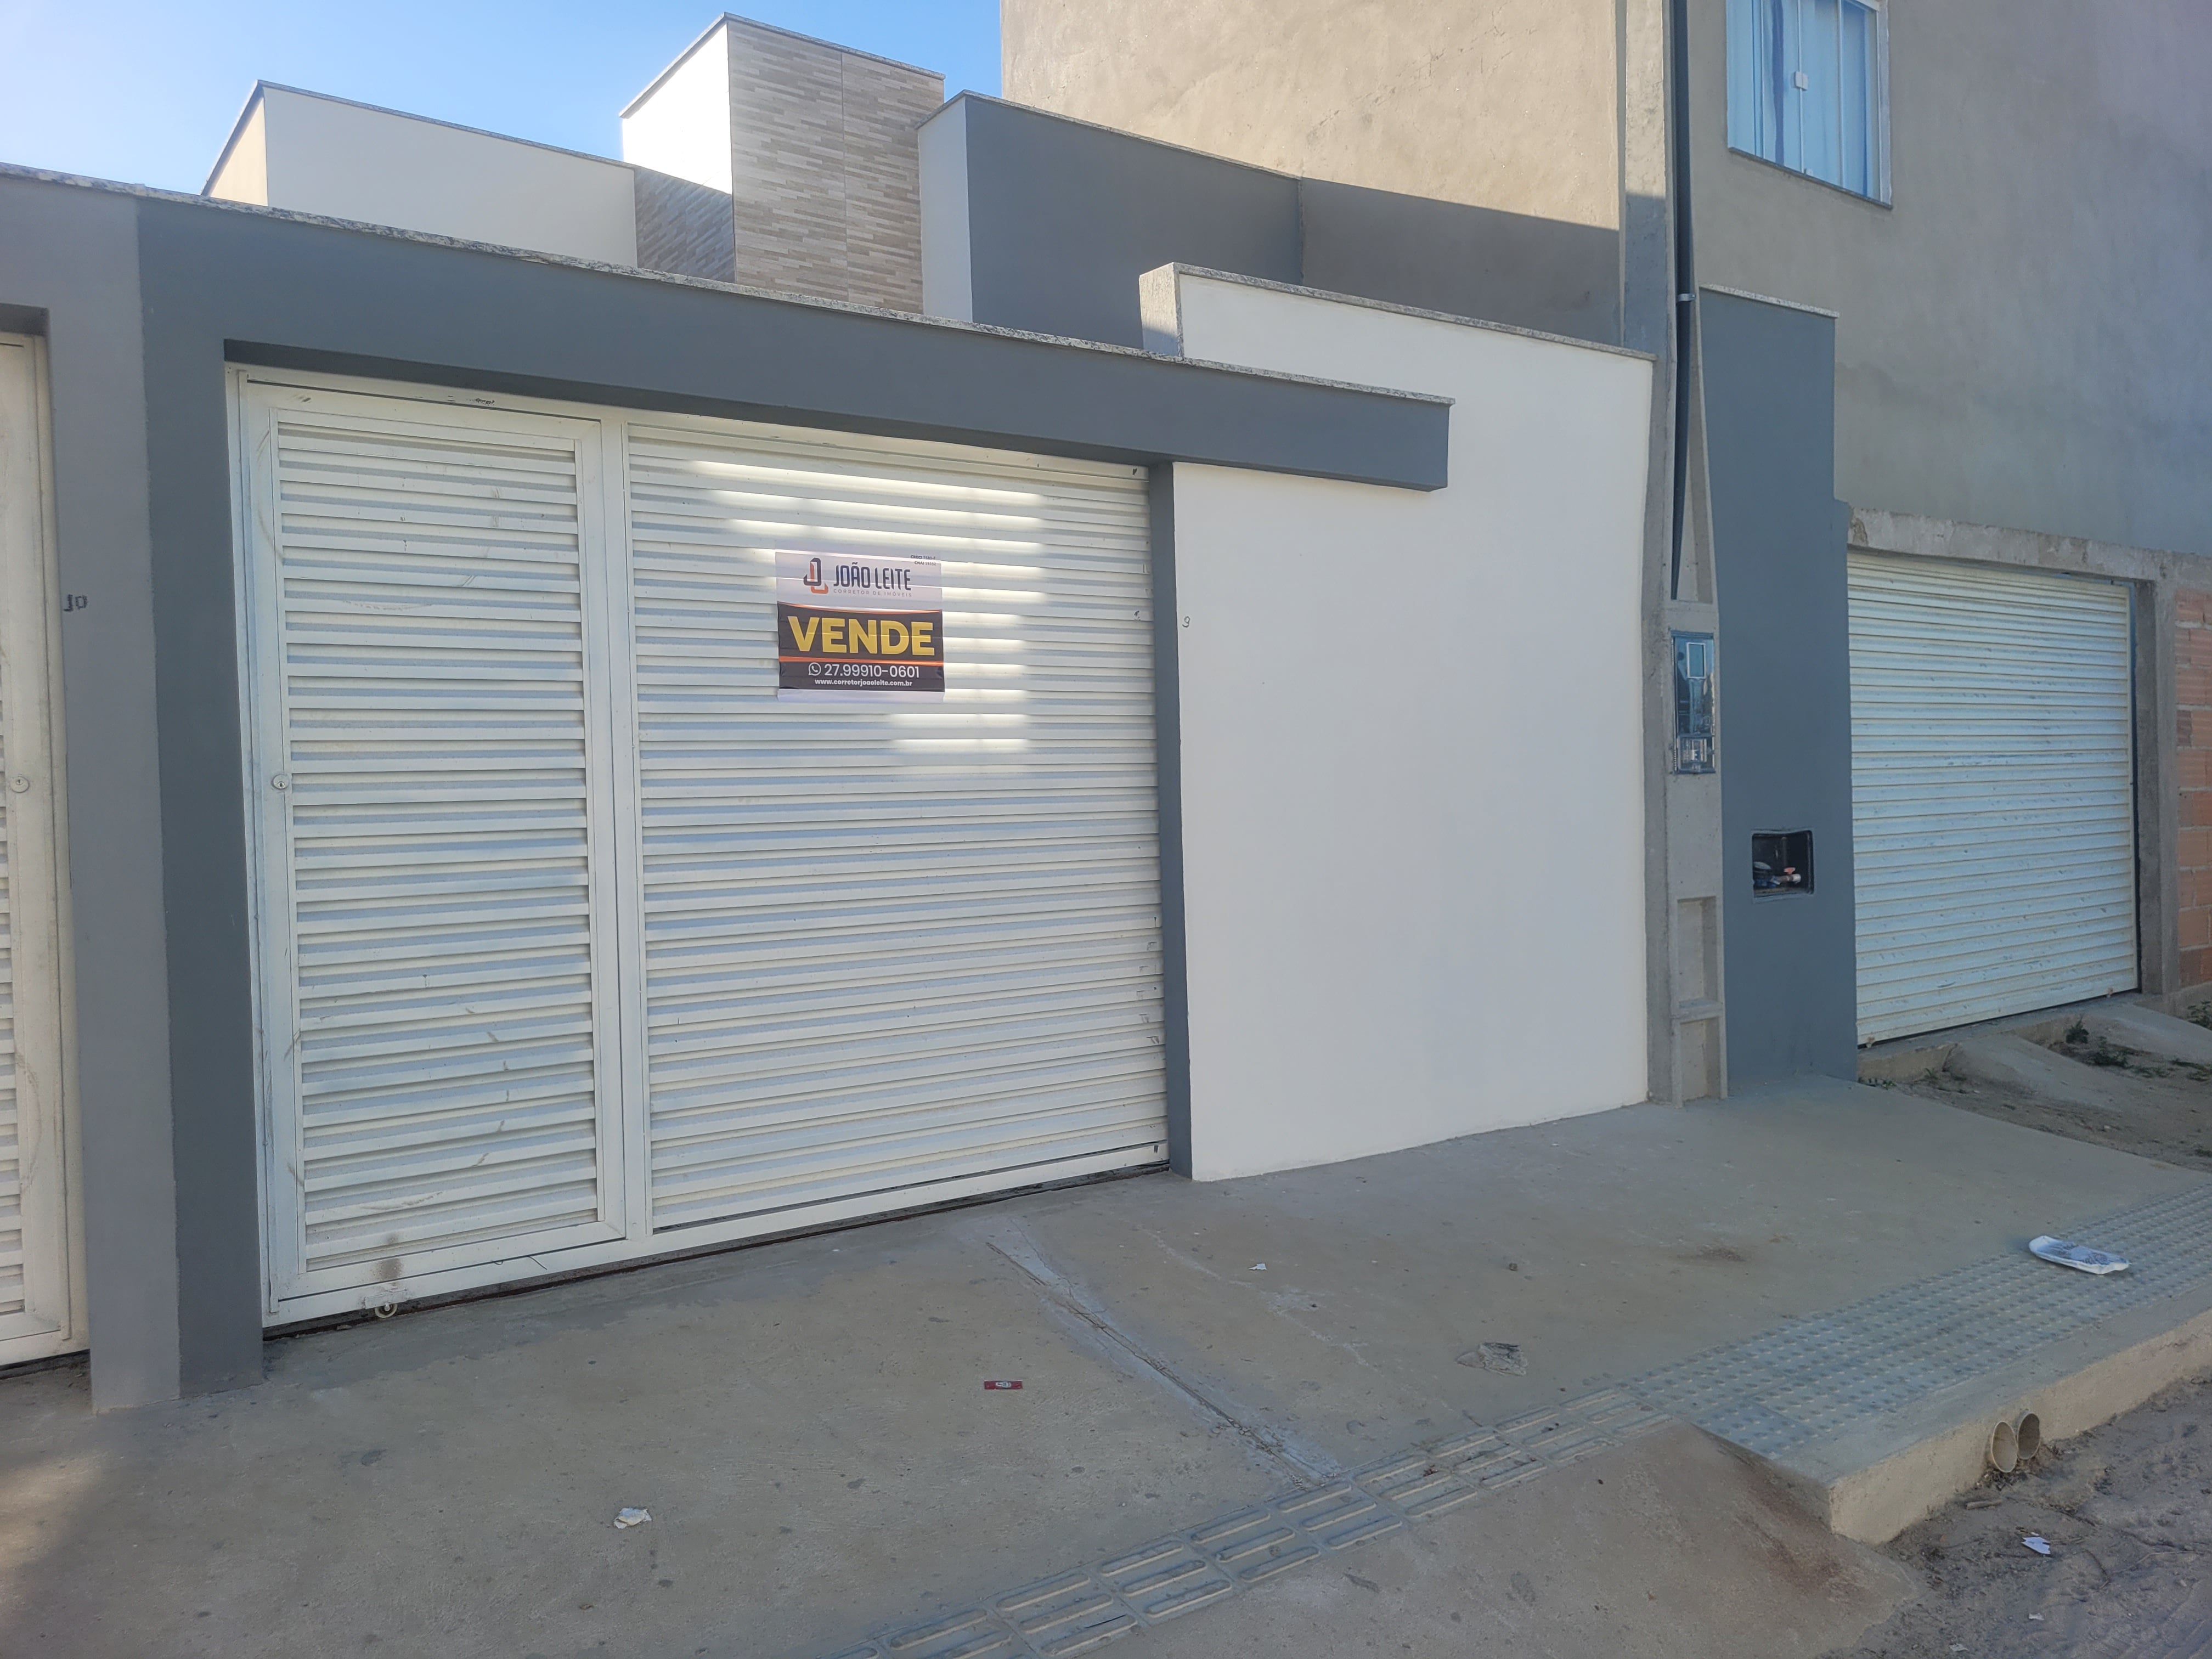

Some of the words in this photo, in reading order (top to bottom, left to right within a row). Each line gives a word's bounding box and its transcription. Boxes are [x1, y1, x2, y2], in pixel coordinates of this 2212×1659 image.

[833, 561, 871, 589] JOÃO
[874, 567, 912, 591] LEITE
[787, 616, 935, 656] VENDE
[824, 664, 919, 678] 27.99910-0601
[815, 679, 913, 687] www.corretorjoaoleite.com.br
